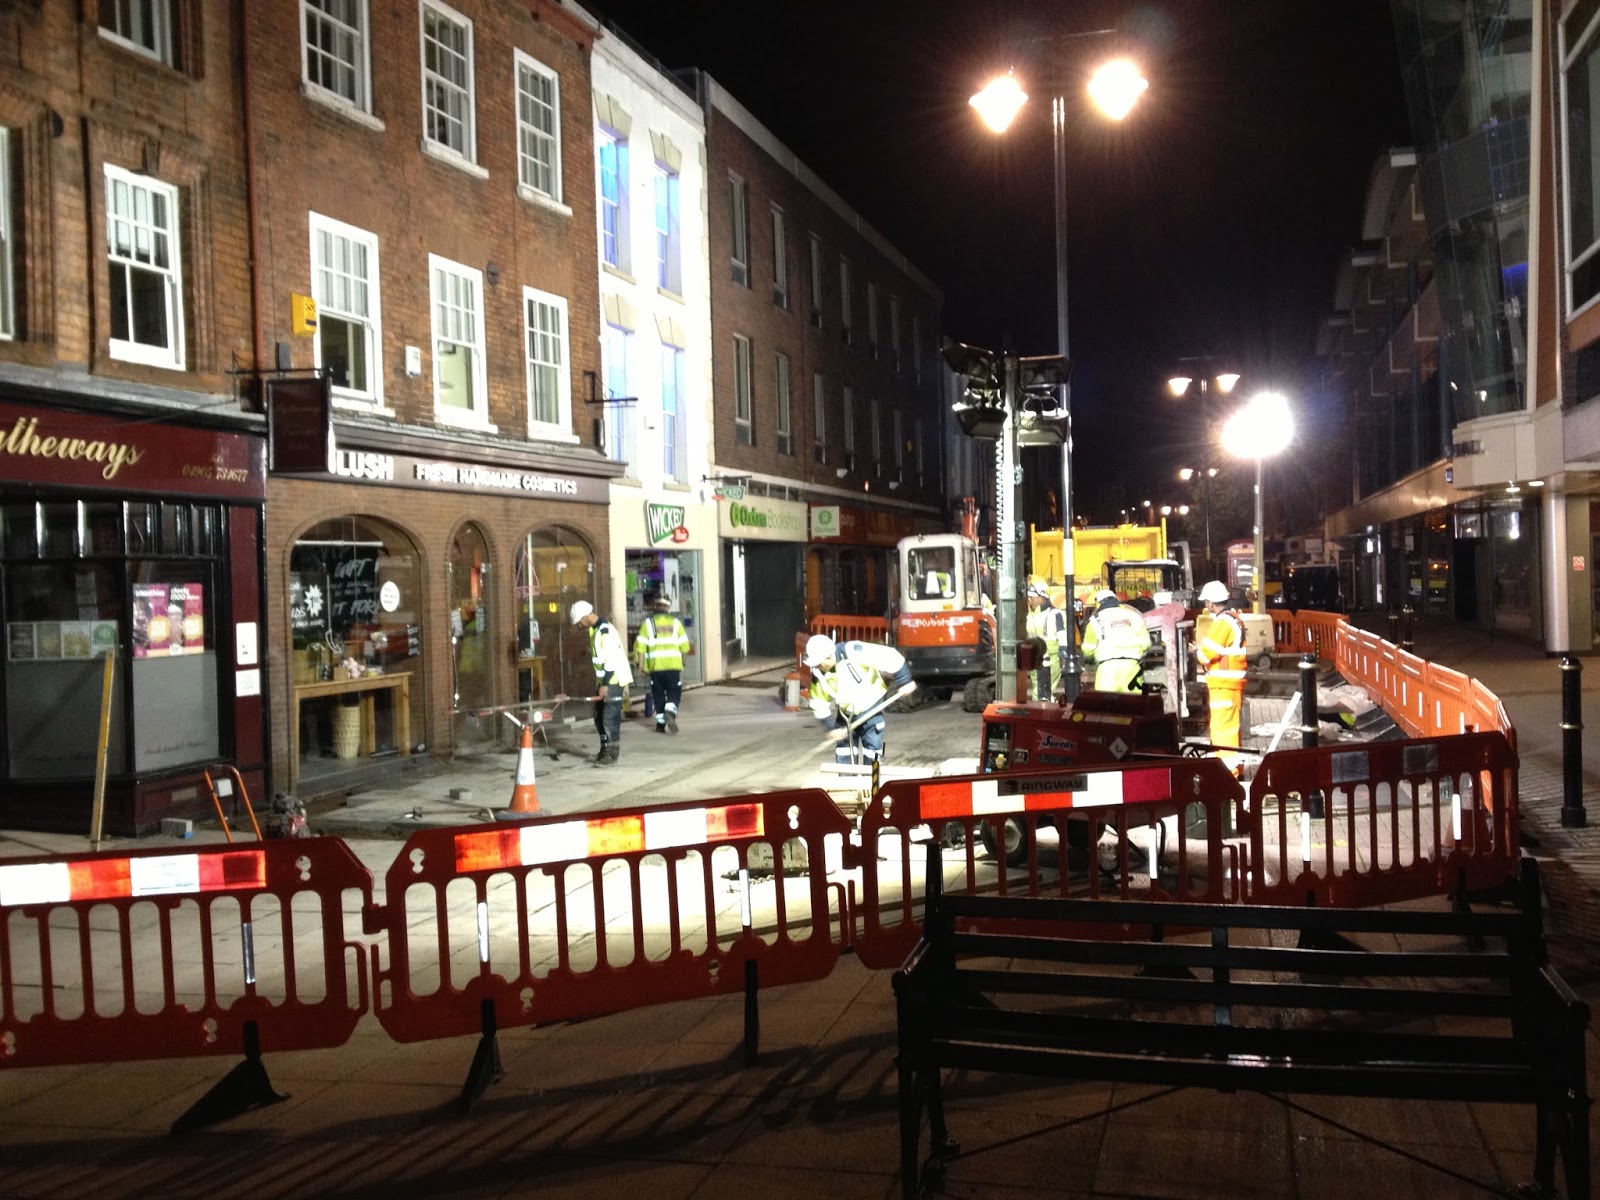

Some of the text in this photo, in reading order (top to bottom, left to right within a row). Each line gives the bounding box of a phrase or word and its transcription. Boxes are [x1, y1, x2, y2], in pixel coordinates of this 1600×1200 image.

[0, 416, 145, 480] theways
[336, 449, 577, 495] LUSH FRESH HANDMADE COSMETICS
[649, 505, 684, 541] WICKED
[740, 504, 767, 528] Oxfam
[1021, 779, 1083, 793] RINGWAY
